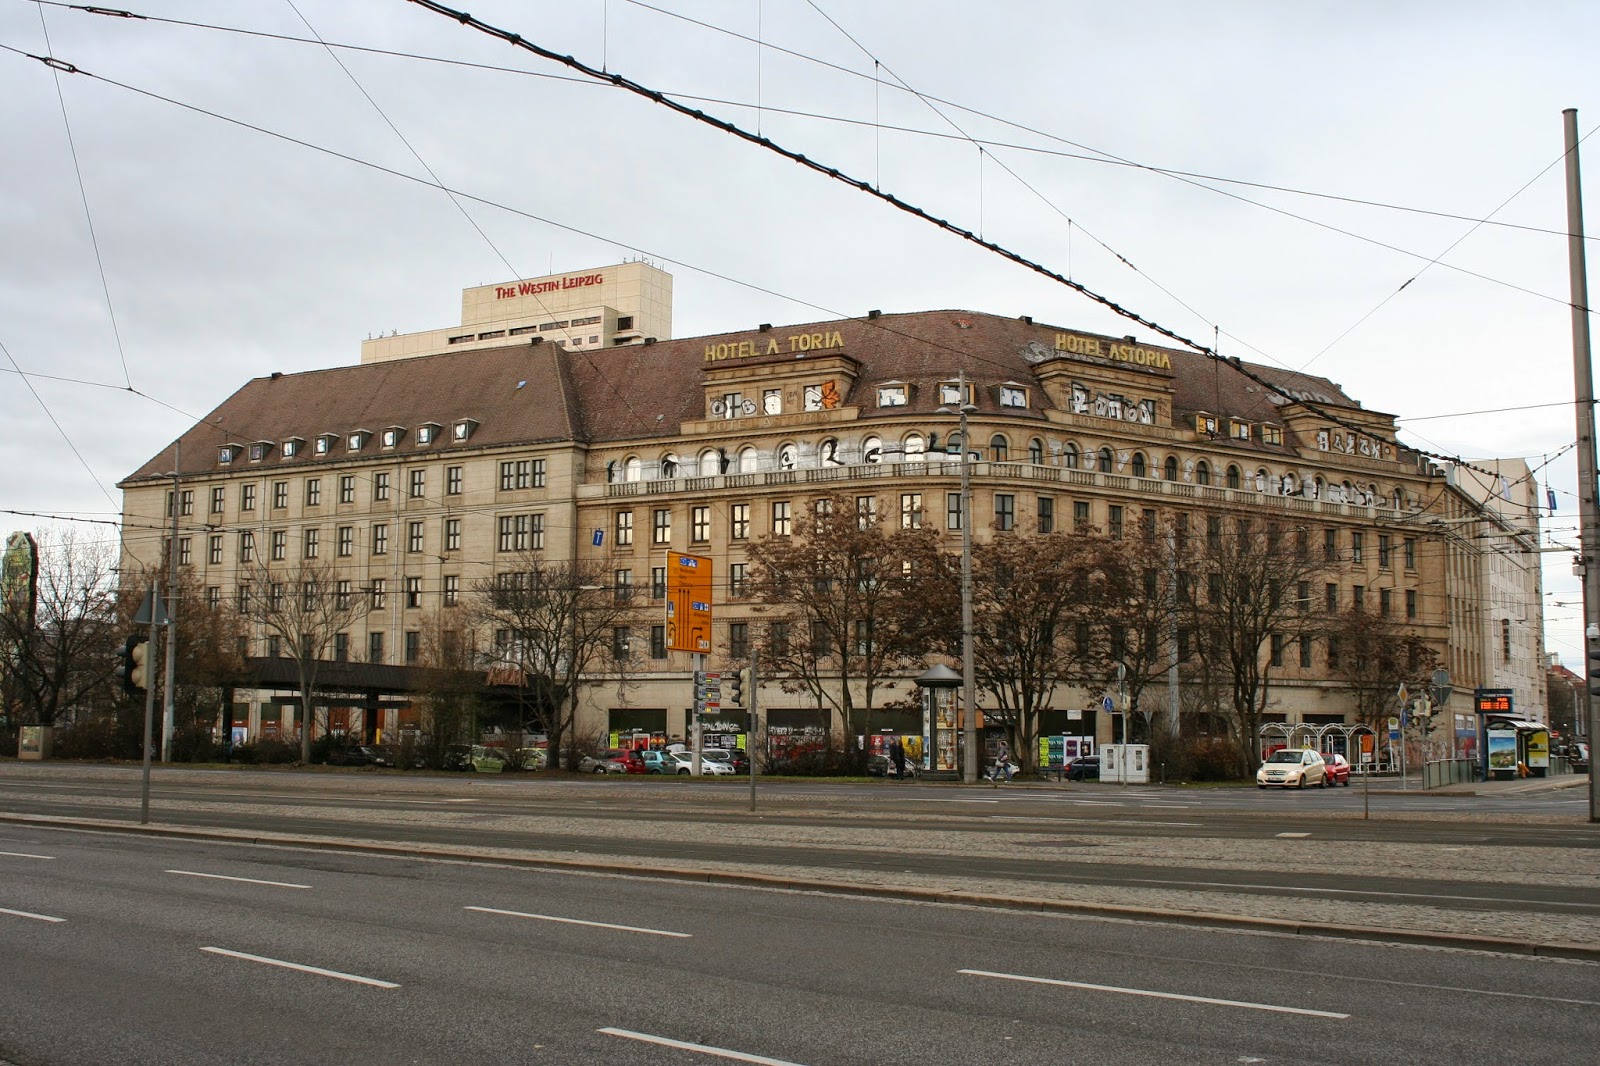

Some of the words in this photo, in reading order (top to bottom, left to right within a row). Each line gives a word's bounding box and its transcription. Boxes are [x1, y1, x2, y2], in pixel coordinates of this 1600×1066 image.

[704, 339, 760, 361] HOTEL
[1055, 333, 1104, 357] HOTEL
[1109, 343, 1171, 370] ASTORIA
[707, 419, 755, 432] HOTEL
[761, 412, 830, 428] ASTORIA
[1073, 415, 1115, 431] HOTEL
[1120, 422, 1175, 439] ASTORIA
